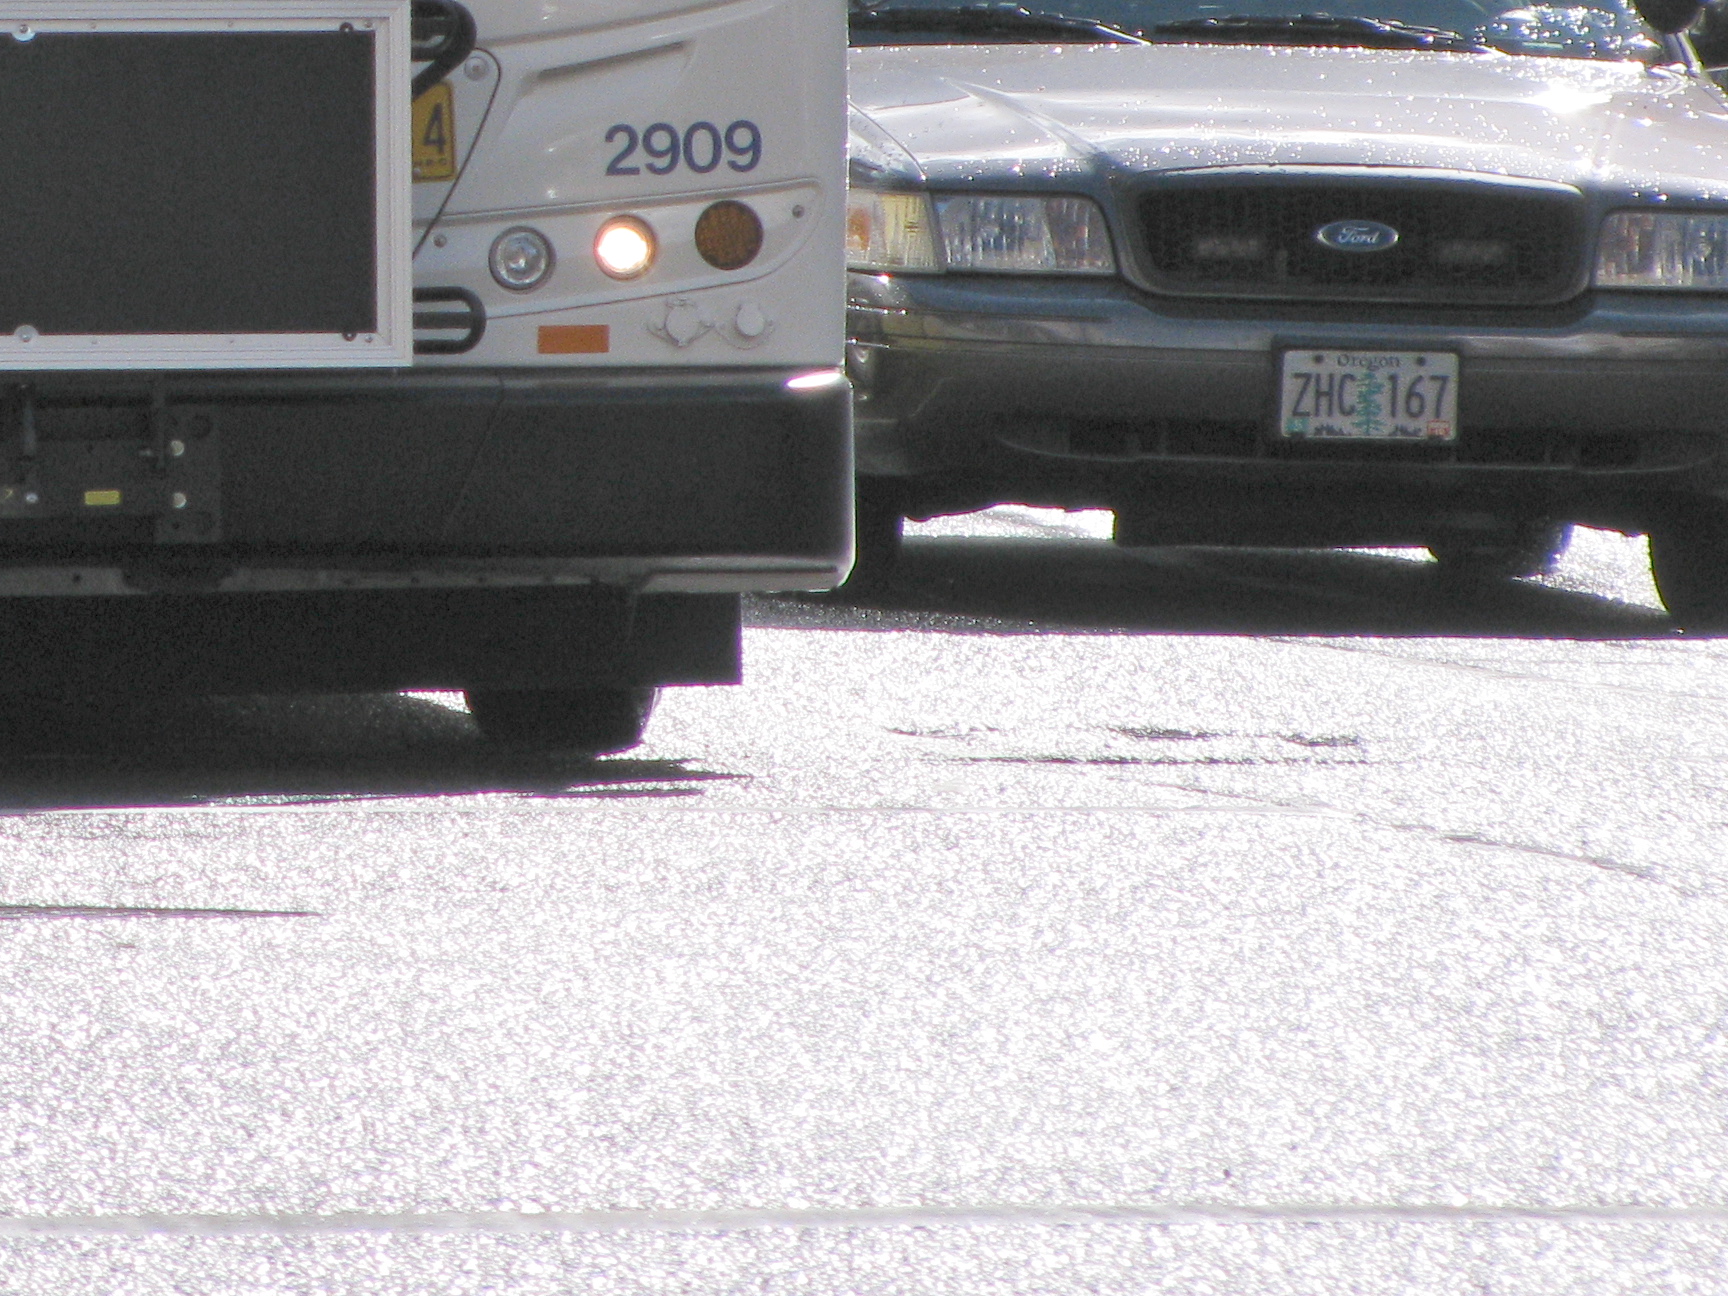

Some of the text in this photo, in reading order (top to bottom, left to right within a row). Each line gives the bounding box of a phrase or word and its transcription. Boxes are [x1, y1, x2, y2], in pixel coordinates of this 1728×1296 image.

[423, 102, 446, 154] 4
[604, 119, 763, 177] 2909
[1336, 226, 1379, 245] Ford
[1336, 353, 1401, 372] Oregon
[1291, 372, 1450, 420] ZHC 167
